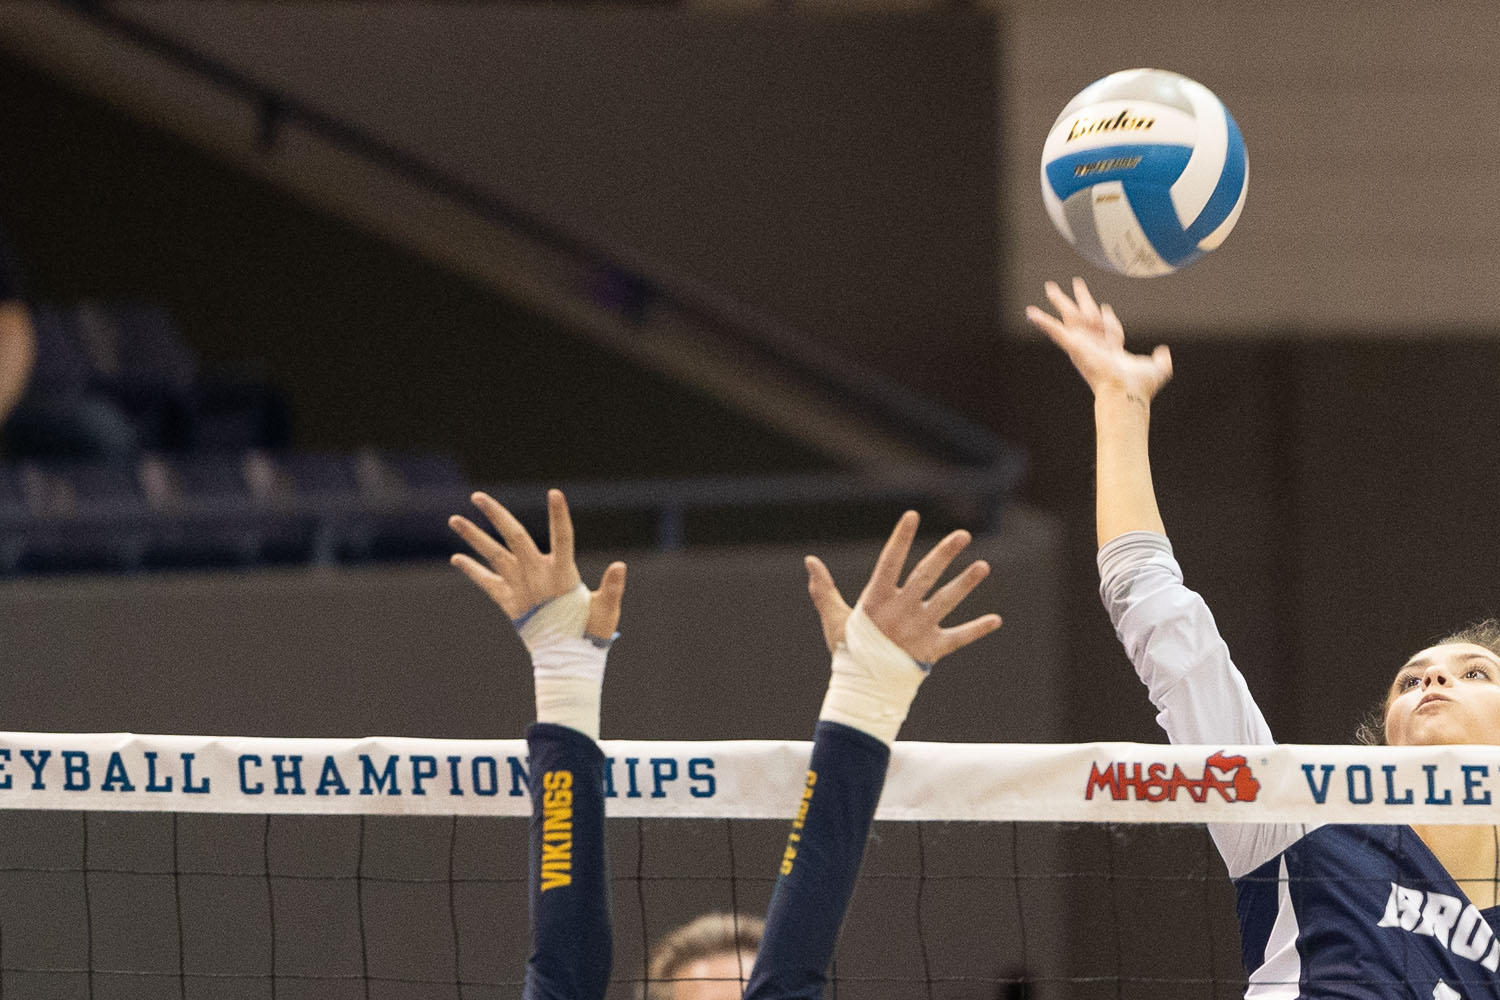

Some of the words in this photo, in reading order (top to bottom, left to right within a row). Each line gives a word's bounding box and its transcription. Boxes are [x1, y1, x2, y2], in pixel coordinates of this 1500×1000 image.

[237, 753, 716, 798] CHAMPIONIPS
[1085, 754, 1243, 803] MHSAA
[541, 770, 573, 892] VIKINGS
